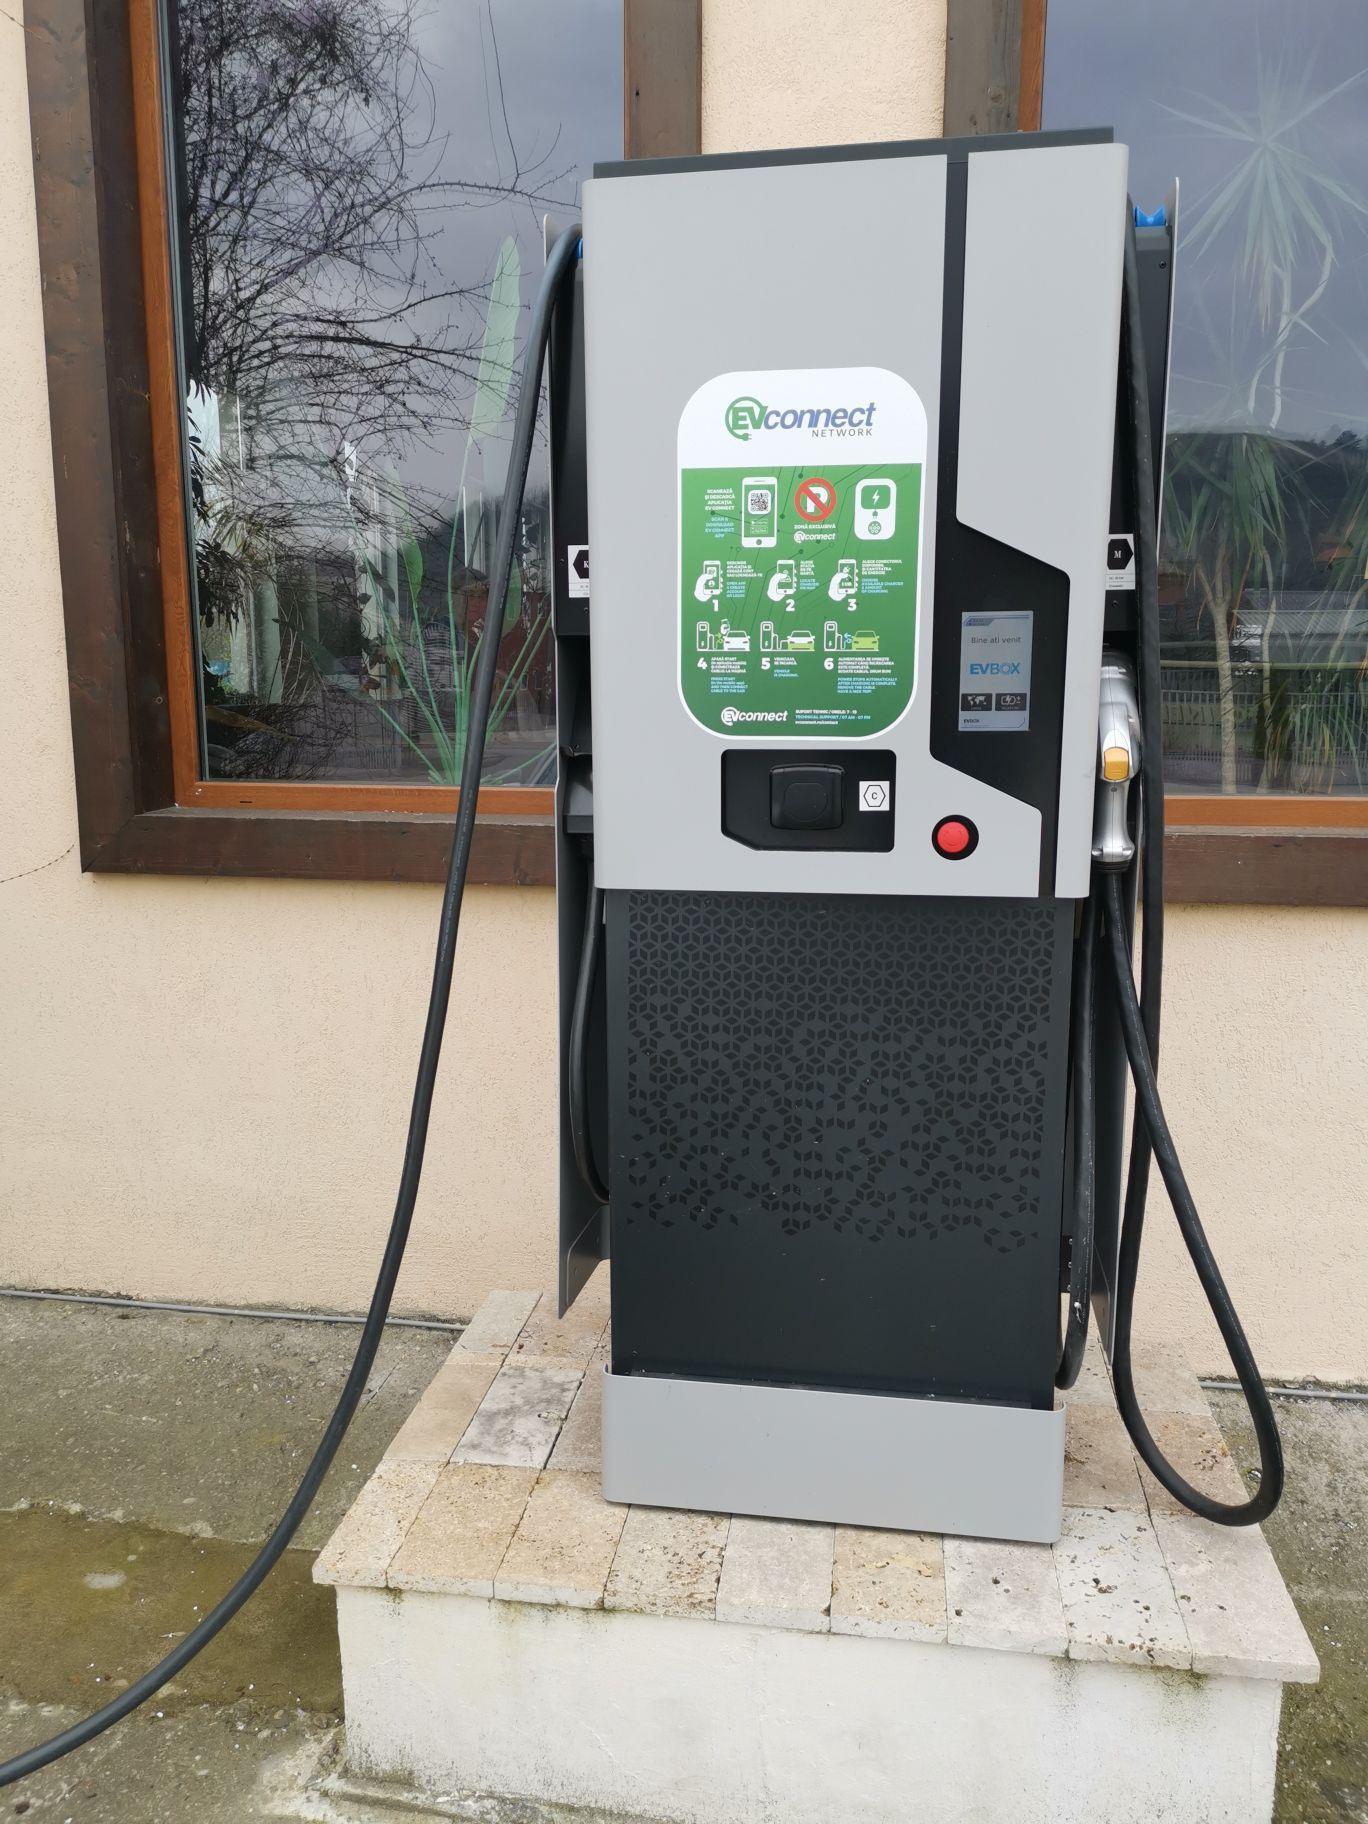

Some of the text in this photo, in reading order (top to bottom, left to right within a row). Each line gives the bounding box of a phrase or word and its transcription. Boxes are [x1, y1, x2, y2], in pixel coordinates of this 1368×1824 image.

[811, 428, 873, 439] NETWORK
[1114, 550, 1121, 559] M
[712, 599, 719, 612] 1
[786, 599, 795, 612] 2
[847, 598, 857, 612] 3
[697, 657, 708, 670] 4
[761, 657, 771, 670] 5
[824, 657, 834, 670] 6
[970, 662, 1021, 675] EVBOX
[871, 792, 878, 800] C
